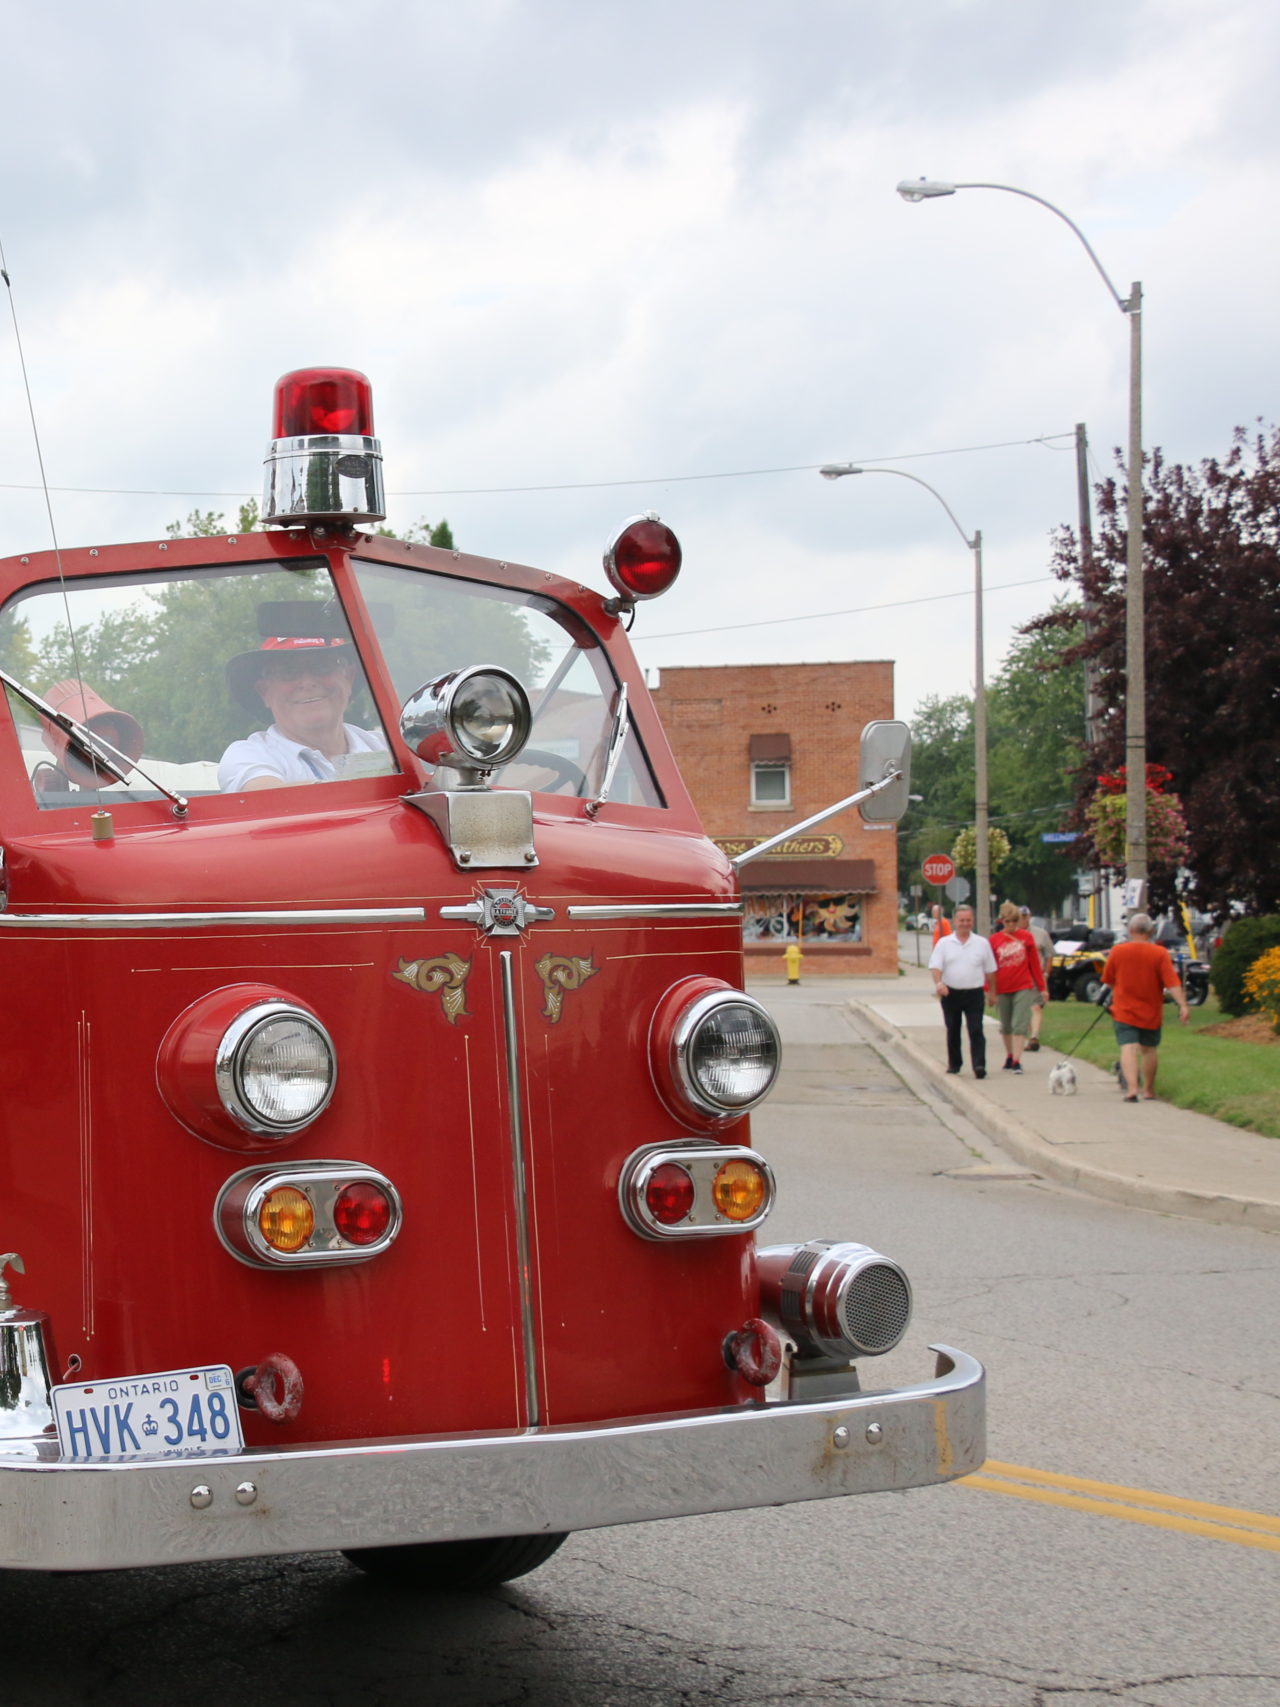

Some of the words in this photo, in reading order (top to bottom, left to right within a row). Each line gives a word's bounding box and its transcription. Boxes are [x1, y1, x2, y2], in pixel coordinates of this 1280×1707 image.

[924, 863, 952, 876] STOP
[208, 1375, 222, 1384] DEC
[108, 1380, 179, 1400] ONTARIO
[66, 1402, 141, 1456] HVK
[160, 1391, 230, 1446] 348
